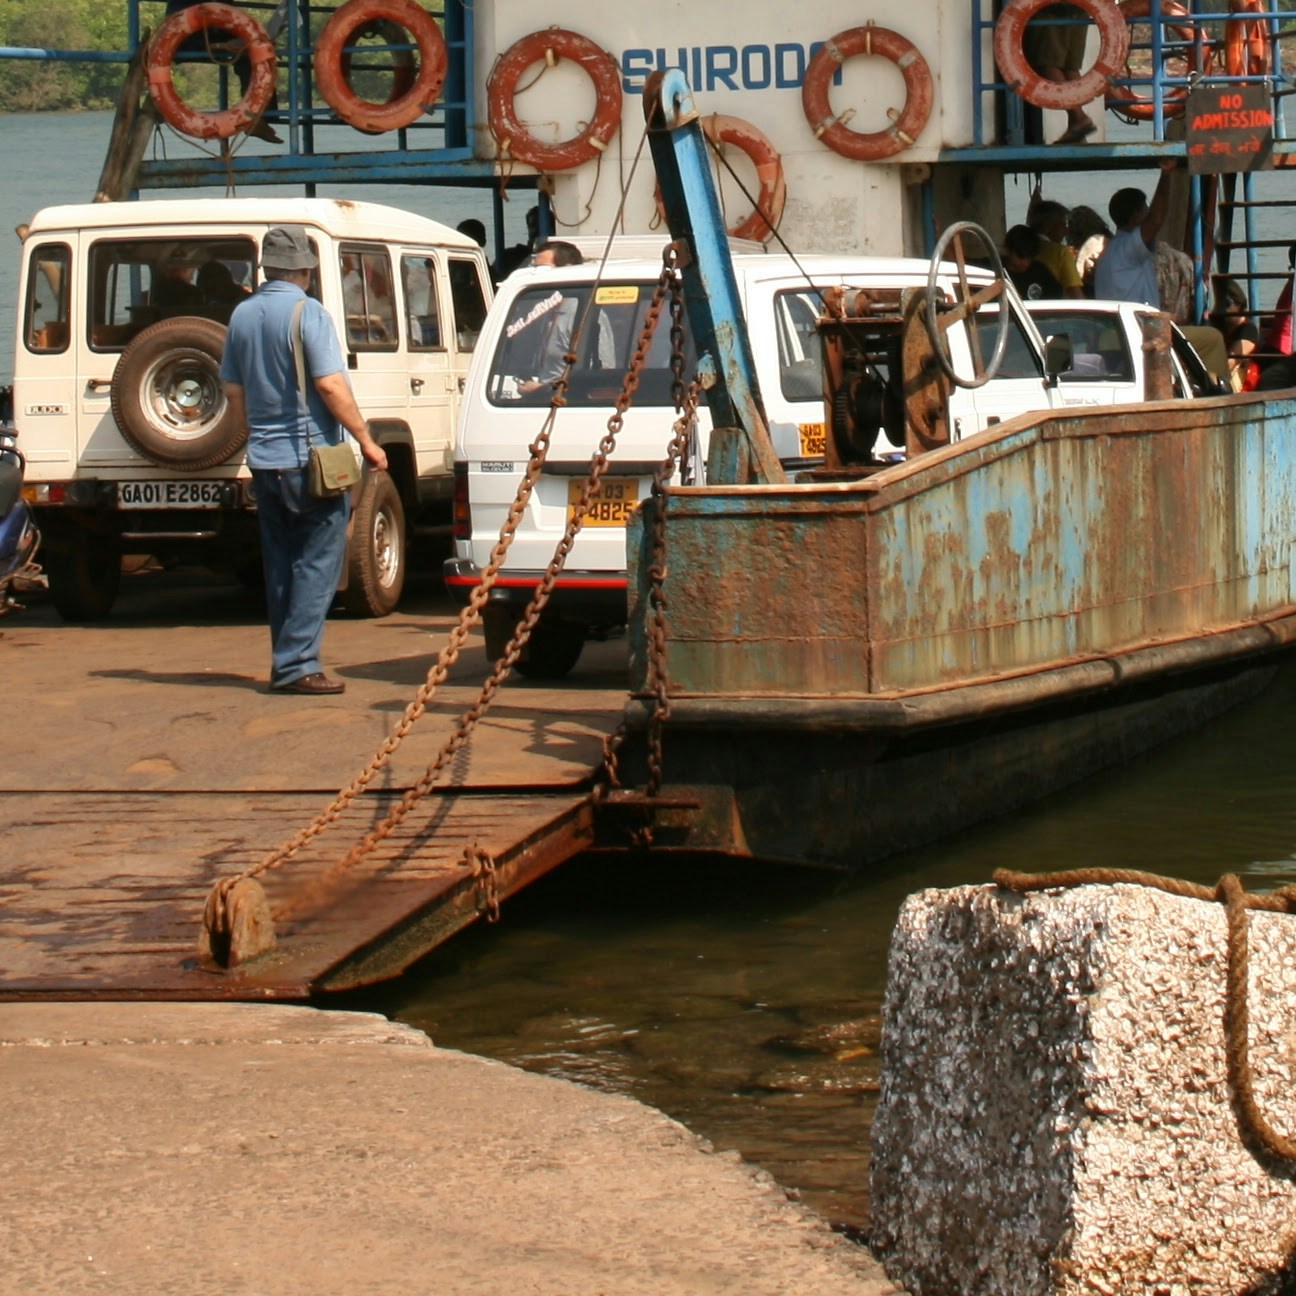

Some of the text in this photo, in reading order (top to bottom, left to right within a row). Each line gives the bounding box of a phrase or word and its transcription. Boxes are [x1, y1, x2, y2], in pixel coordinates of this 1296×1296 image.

[1219, 93, 1244, 110] NO
[1192, 108, 1273, 132] ADMISSION
[122, 484, 224, 503] GA01 E2862
[605, 484, 625, 499] 03
[588, 502, 633, 521] 4825
